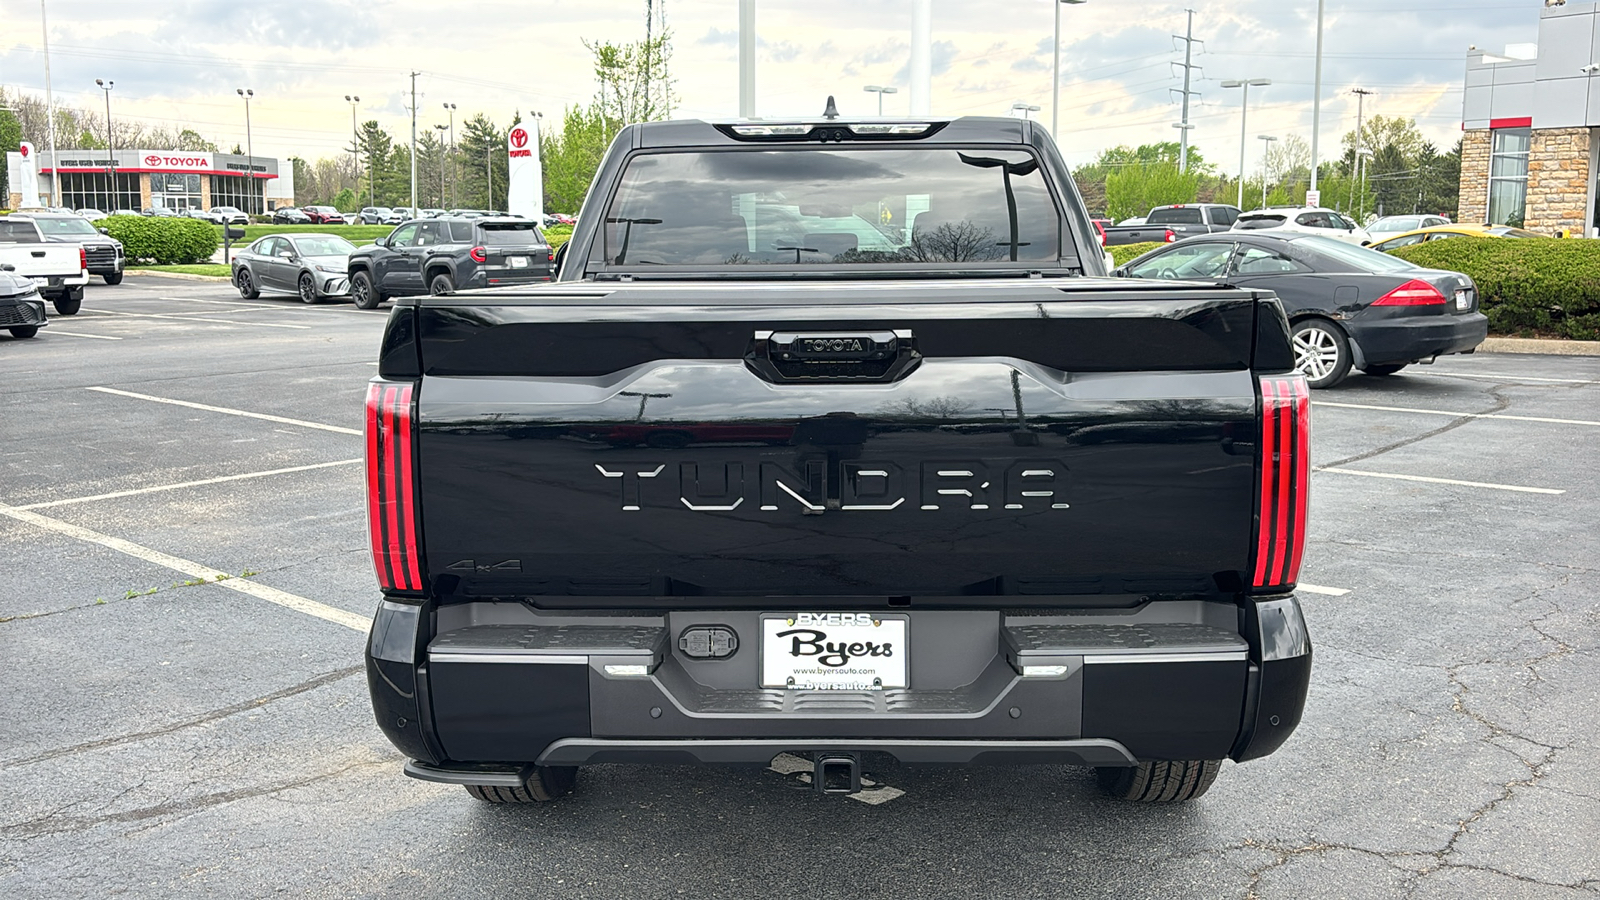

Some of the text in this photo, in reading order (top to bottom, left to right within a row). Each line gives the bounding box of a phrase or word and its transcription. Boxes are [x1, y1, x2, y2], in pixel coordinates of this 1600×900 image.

[163, 157, 208, 167] TOYOTA
[804, 338, 863, 352] TOYOTA
[594, 459, 1070, 512] TUNDRA
[797, 612, 872, 627] BYERS
[775, 629, 893, 668] Byers
[793, 667, 876, 676] www.byersauto.com
[787, 680, 883, 691] www.byersauto.com
